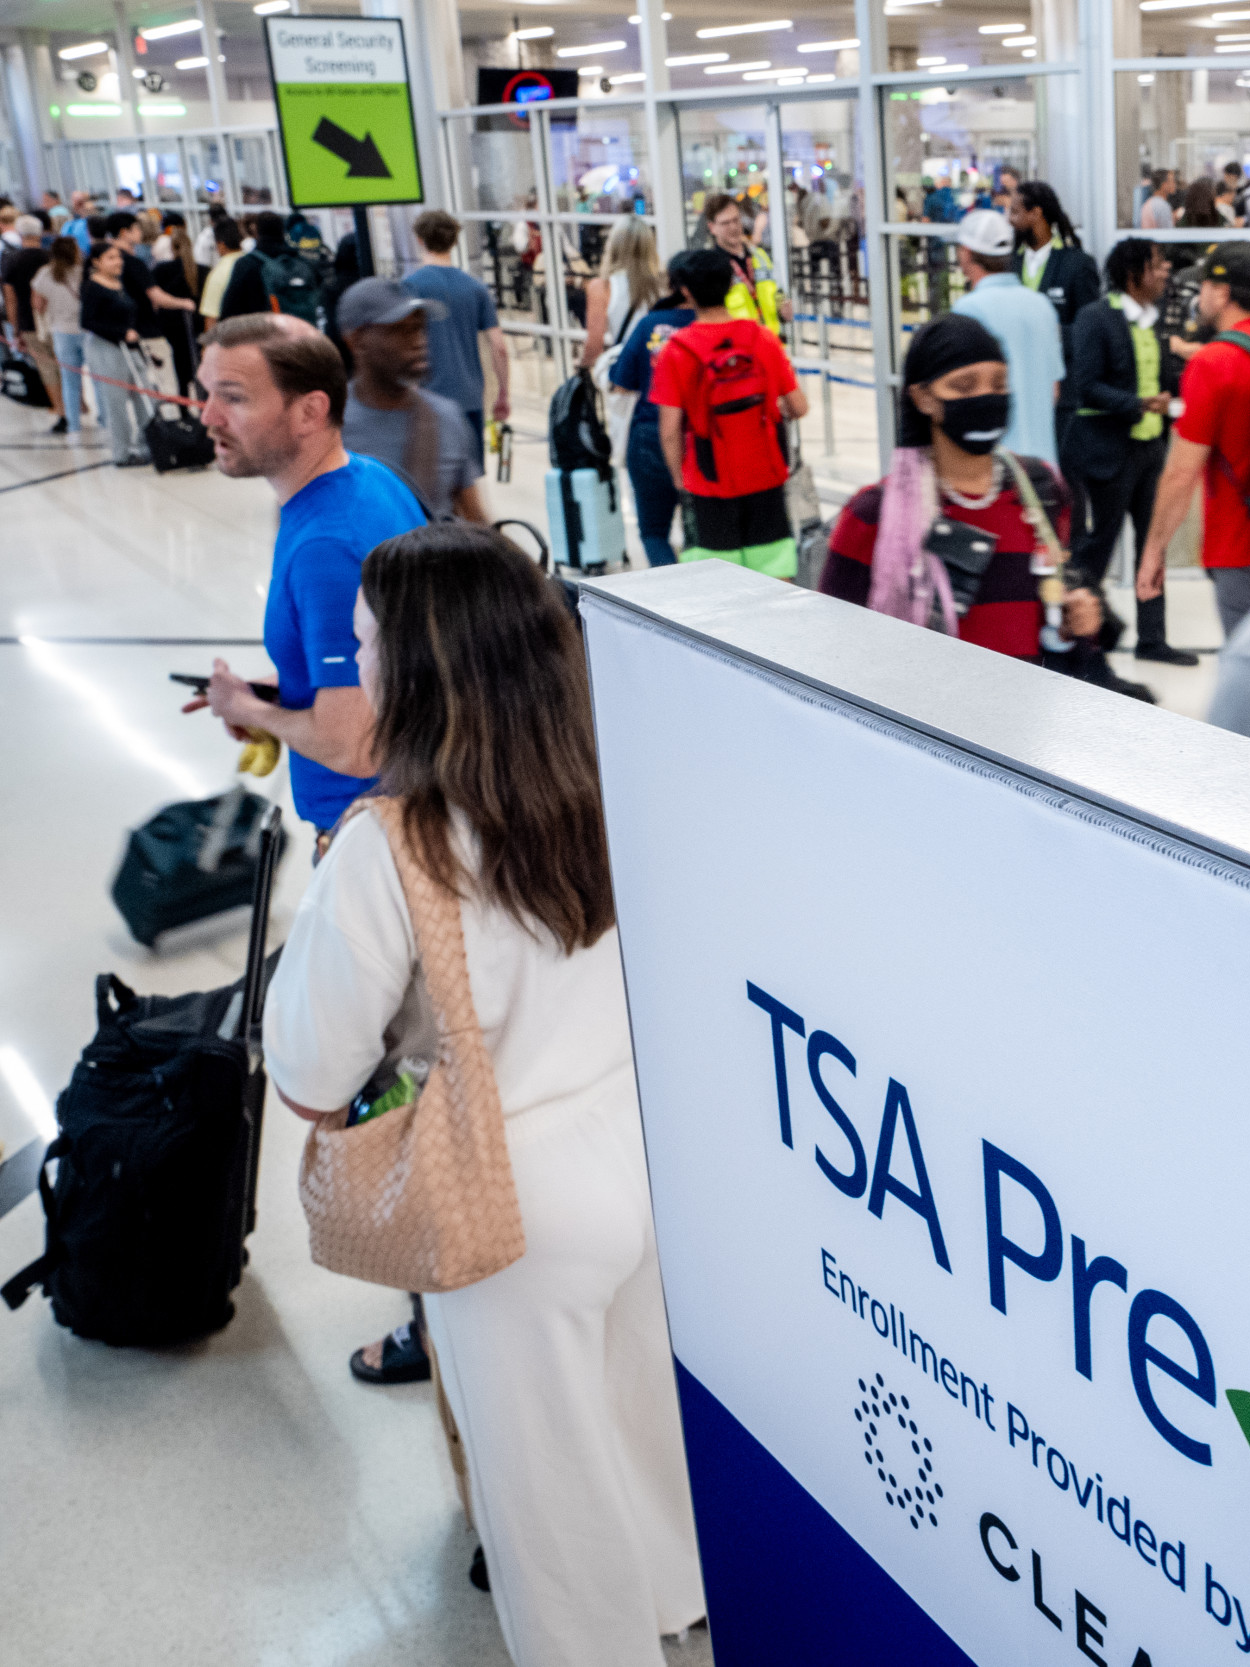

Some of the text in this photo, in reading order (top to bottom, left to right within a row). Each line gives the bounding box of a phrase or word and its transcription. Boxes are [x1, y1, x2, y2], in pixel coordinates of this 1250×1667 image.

[277, 30, 394, 53] General Security
[304, 56, 376, 78] Screening
[747, 980, 952, 1274] TSA
[821, 1248, 996, 1431] Enrollment
[1007, 1402, 1186, 1592] Provided
[979, 1512, 1153, 1667] CLE
